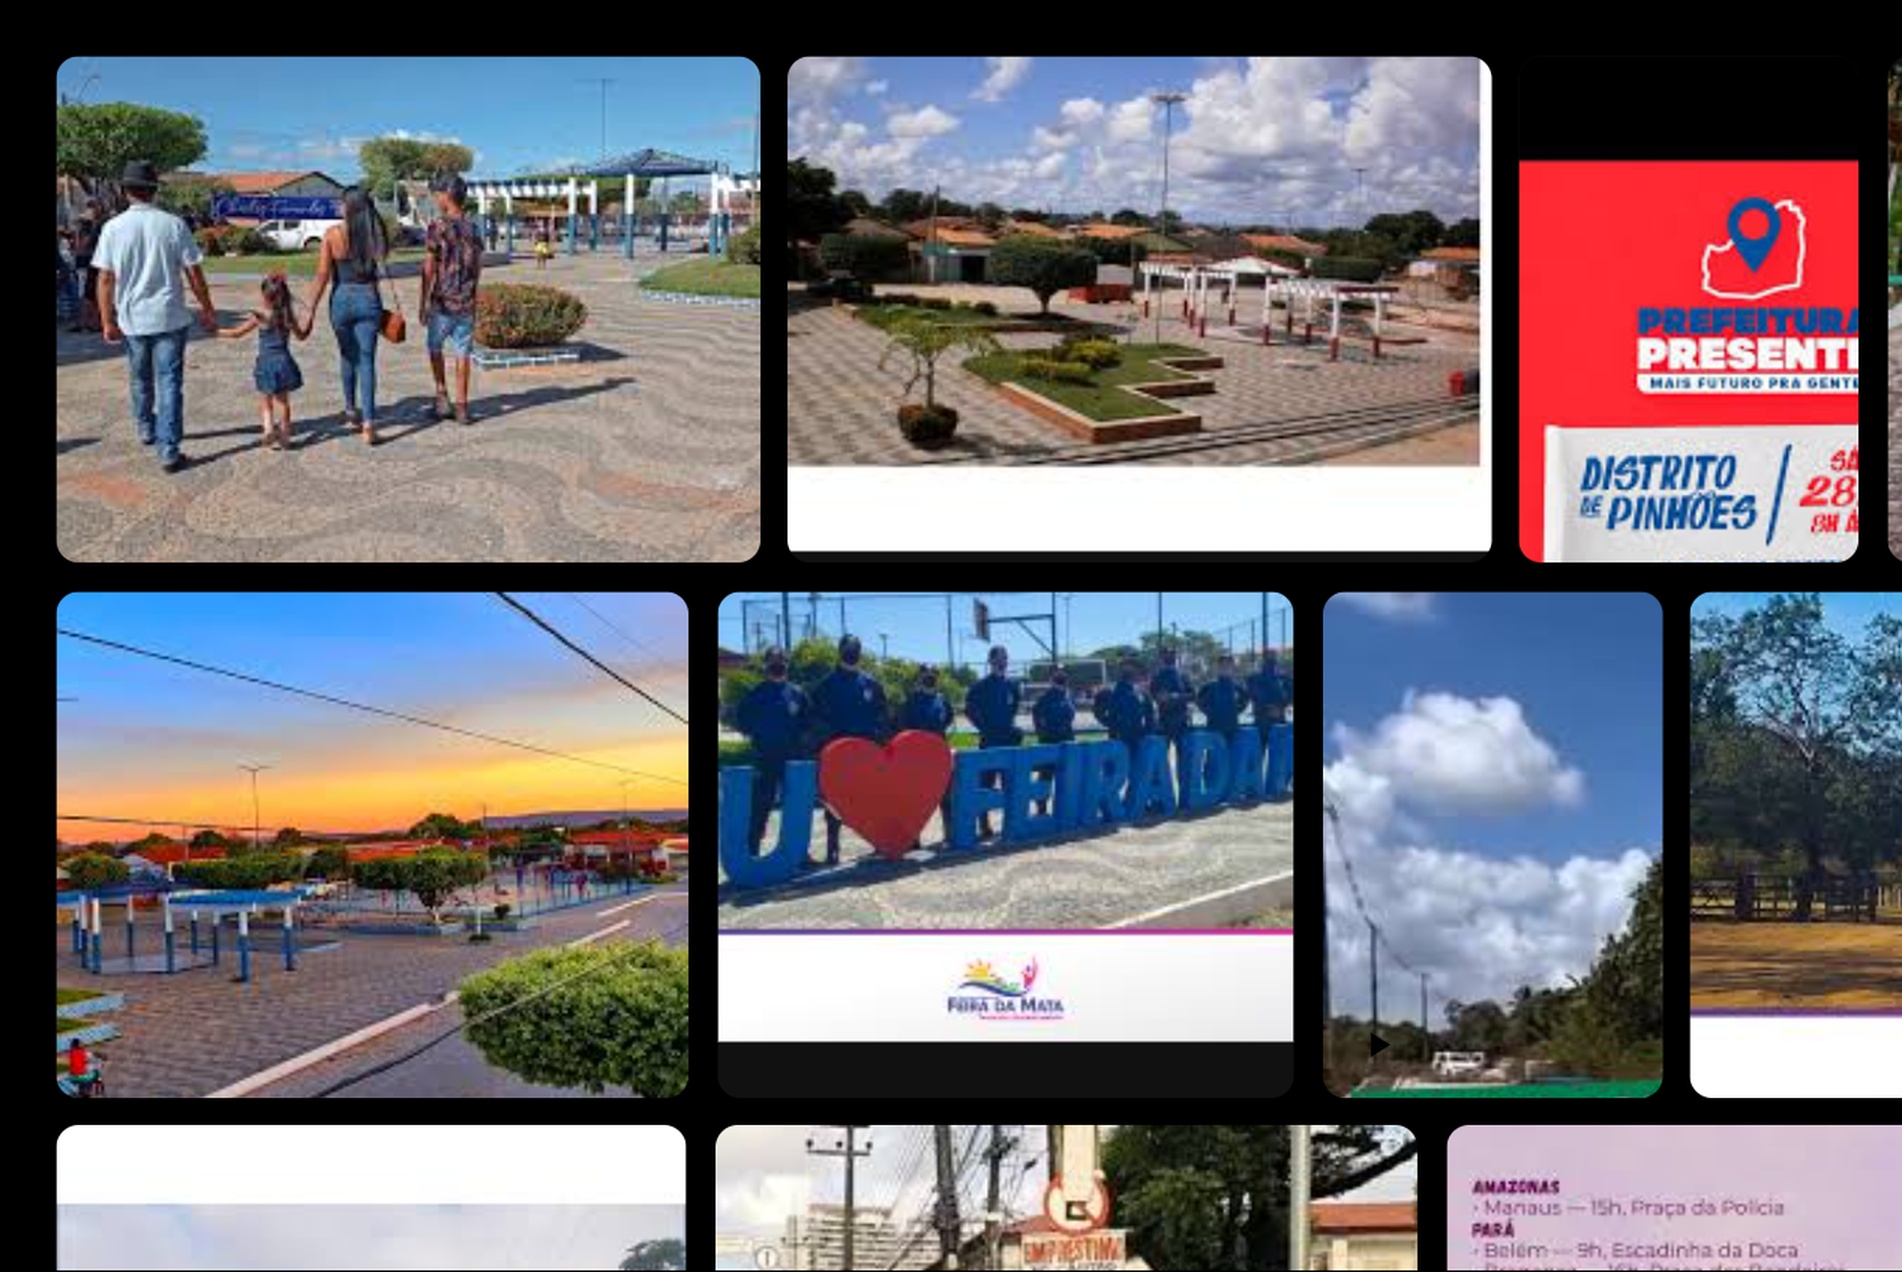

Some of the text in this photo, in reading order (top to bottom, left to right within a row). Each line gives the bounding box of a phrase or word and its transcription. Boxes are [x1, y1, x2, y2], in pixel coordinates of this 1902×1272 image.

[1650, 377, 1691, 388] MAIS
[1698, 377, 1763, 388] FUTURO
[1768, 377, 1801, 388] PRA
[1580, 455, 1737, 490] DISTRITO
[947, 734, 1176, 850] FEIRA
[947, 996, 1064, 1012] FEIRA DA MATA
[1472, 1180, 1560, 1194] AMAZONAS
[1485, 1200, 1562, 1216] Manaus
[1631, 1200, 1686, 1221] Praça
[1691, 1199, 1717, 1216] da
[1472, 1218, 1515, 1238] PARÁ
[1612, 1241, 1712, 1258] Escadinha
[1718, 1241, 1742, 1258] da
[1749, 1243, 1799, 1258] Doca
